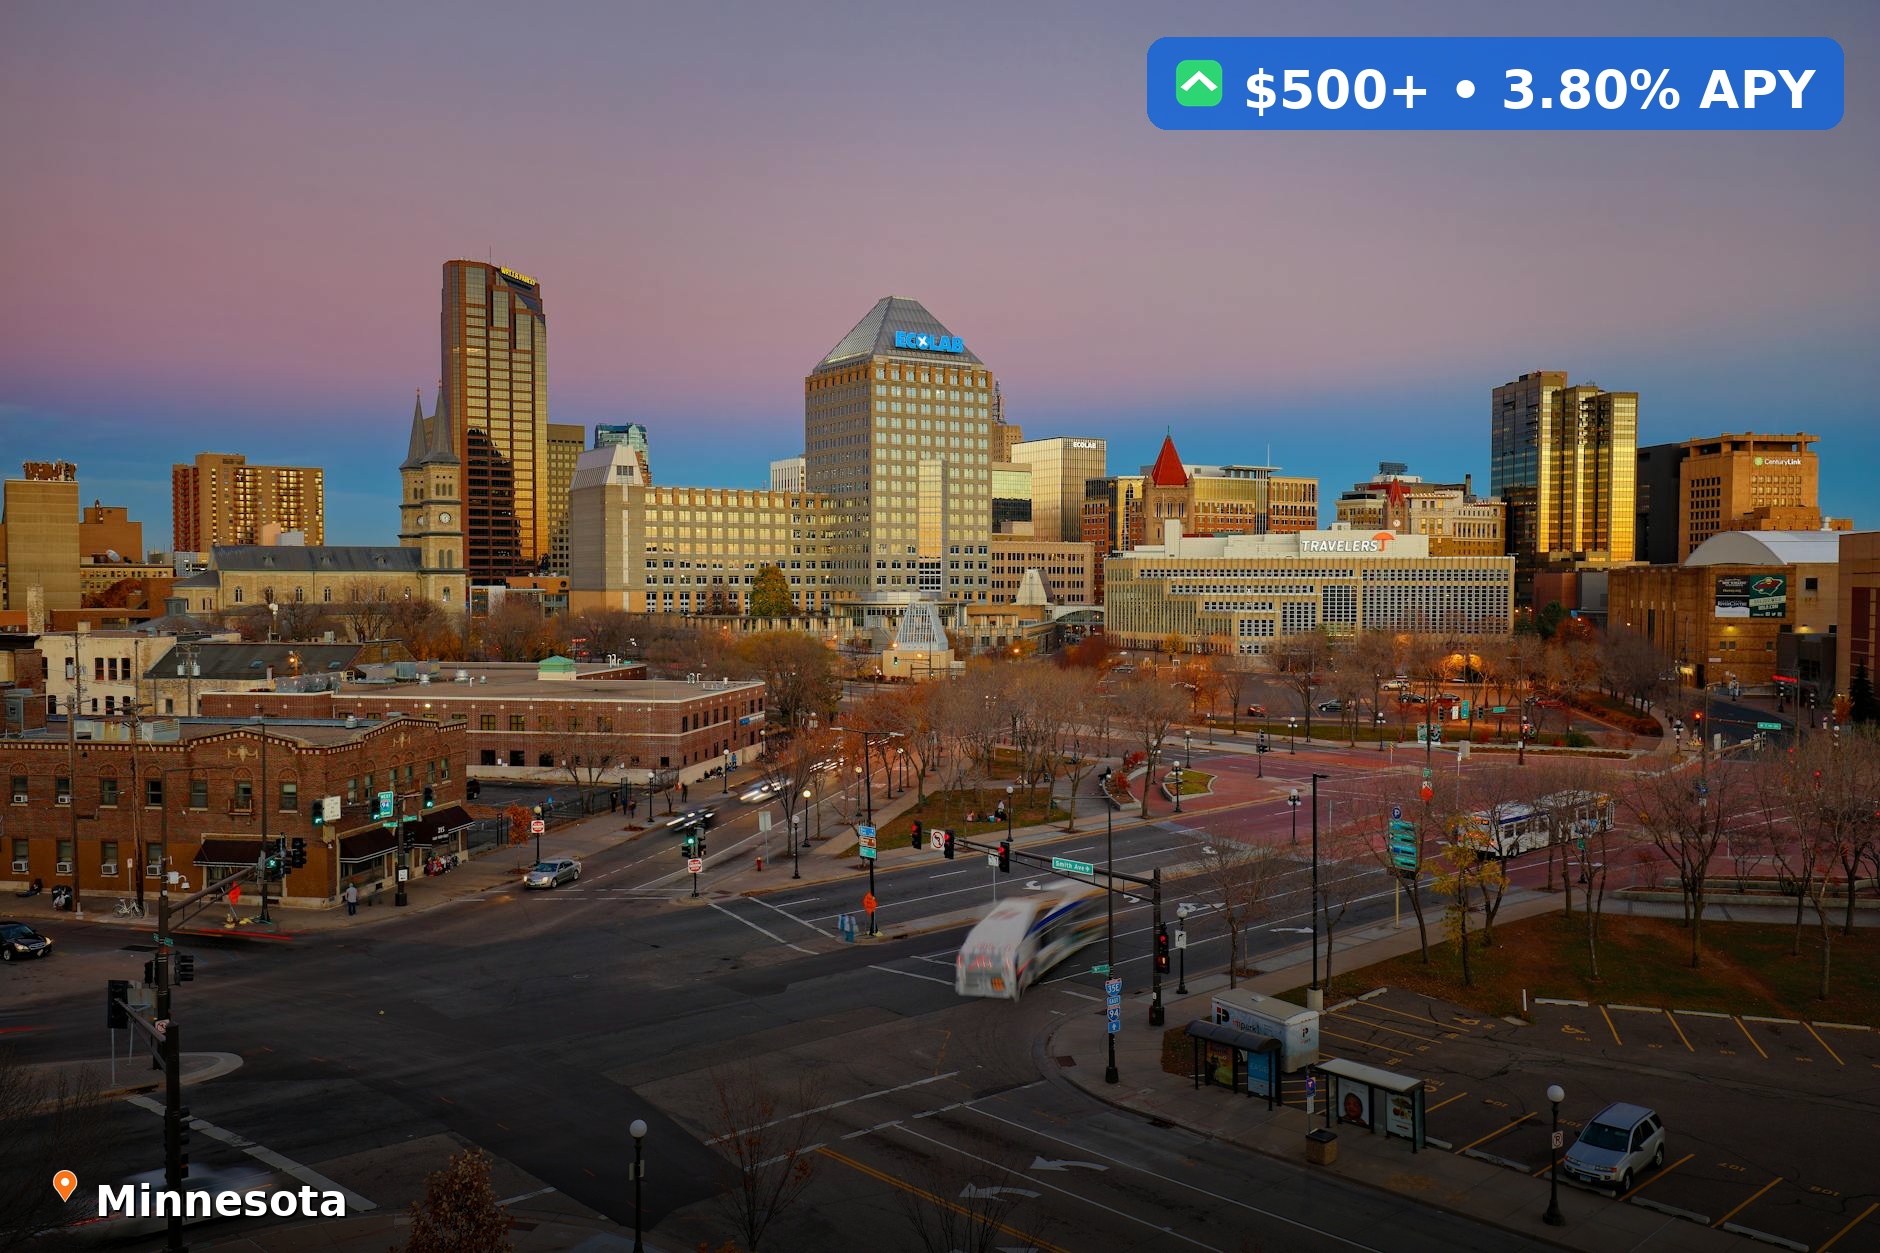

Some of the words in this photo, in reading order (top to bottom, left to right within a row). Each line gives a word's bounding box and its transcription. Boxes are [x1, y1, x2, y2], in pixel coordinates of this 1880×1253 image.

[895, 331, 964, 353] ECOLAB
[1073, 441, 1097, 449] ECOLAB
[1764, 458, 1802, 466] CenturyLink
[1301, 539, 1379, 552] TRAVELERS
[1055, 860, 1073, 869] Smith
[1074, 864, 1085, 872] Ave
[1107, 983, 1120, 993] 35E
[1109, 1009, 1119, 1017] 94
